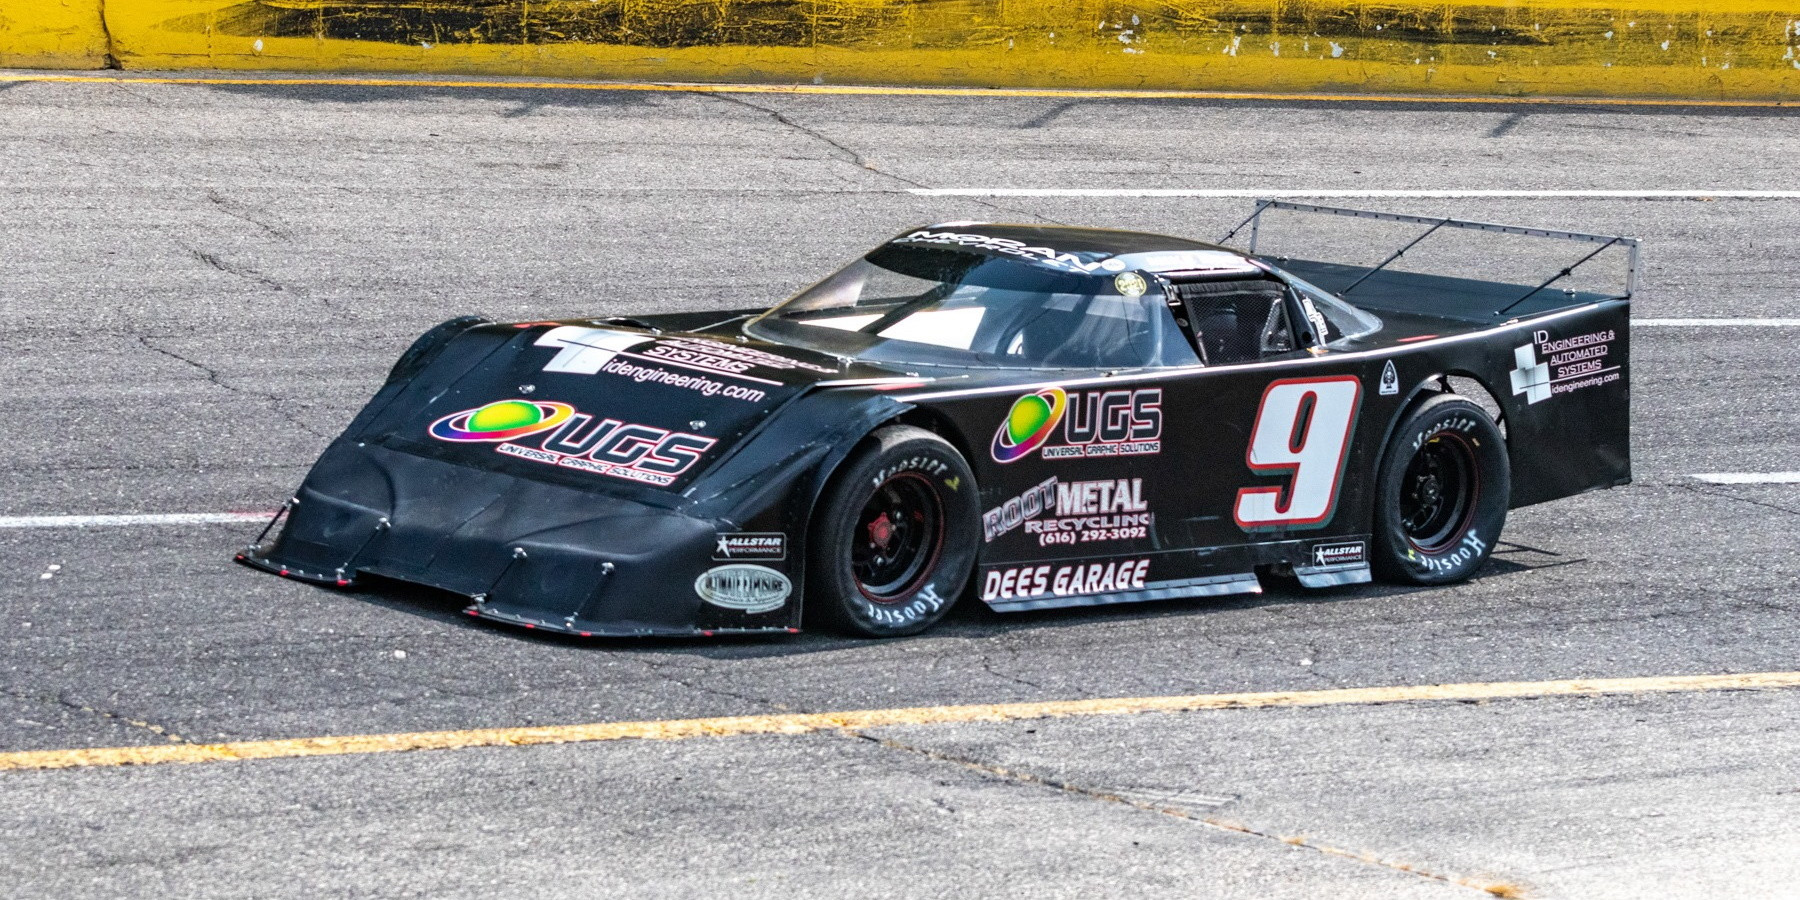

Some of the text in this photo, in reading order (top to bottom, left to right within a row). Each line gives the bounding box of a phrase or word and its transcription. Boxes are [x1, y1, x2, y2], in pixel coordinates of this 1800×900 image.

[907, 230, 1102, 272] MORAN
[1533, 330, 1549, 345] ID
[1542, 329, 1615, 354] ENGINEERING &
[643, 346, 755, 373] SYSTEMS
[1550, 344, 1608, 366] AUTOMATED
[1558, 360, 1602, 378] SYSTEMS
[602, 358, 766, 403] idengineering.com
[1551, 372, 1620, 394] idengineering.com
[1065, 388, 1163, 445] UGS
[541, 412, 719, 476] UGS
[1042, 442, 1161, 458] UNIVERSAL GRAPHIC SOLUTIONS
[1233, 374, 1365, 533] 9
[499, 443, 674, 485] UNIVERSAL GRAPHIC SOLUTIONS
[983, 476, 1148, 542] ROOT METAL
[728, 537, 782, 546] ALLSTAR
[1039, 526, 1146, 546] (616) 292-3092
[1324, 546, 1362, 555] ALLSTAR
[1420, 528, 1486, 575] Hoosier
[983, 559, 1150, 601] DEES GARAGE
[867, 582, 944, 628] Hoosier
